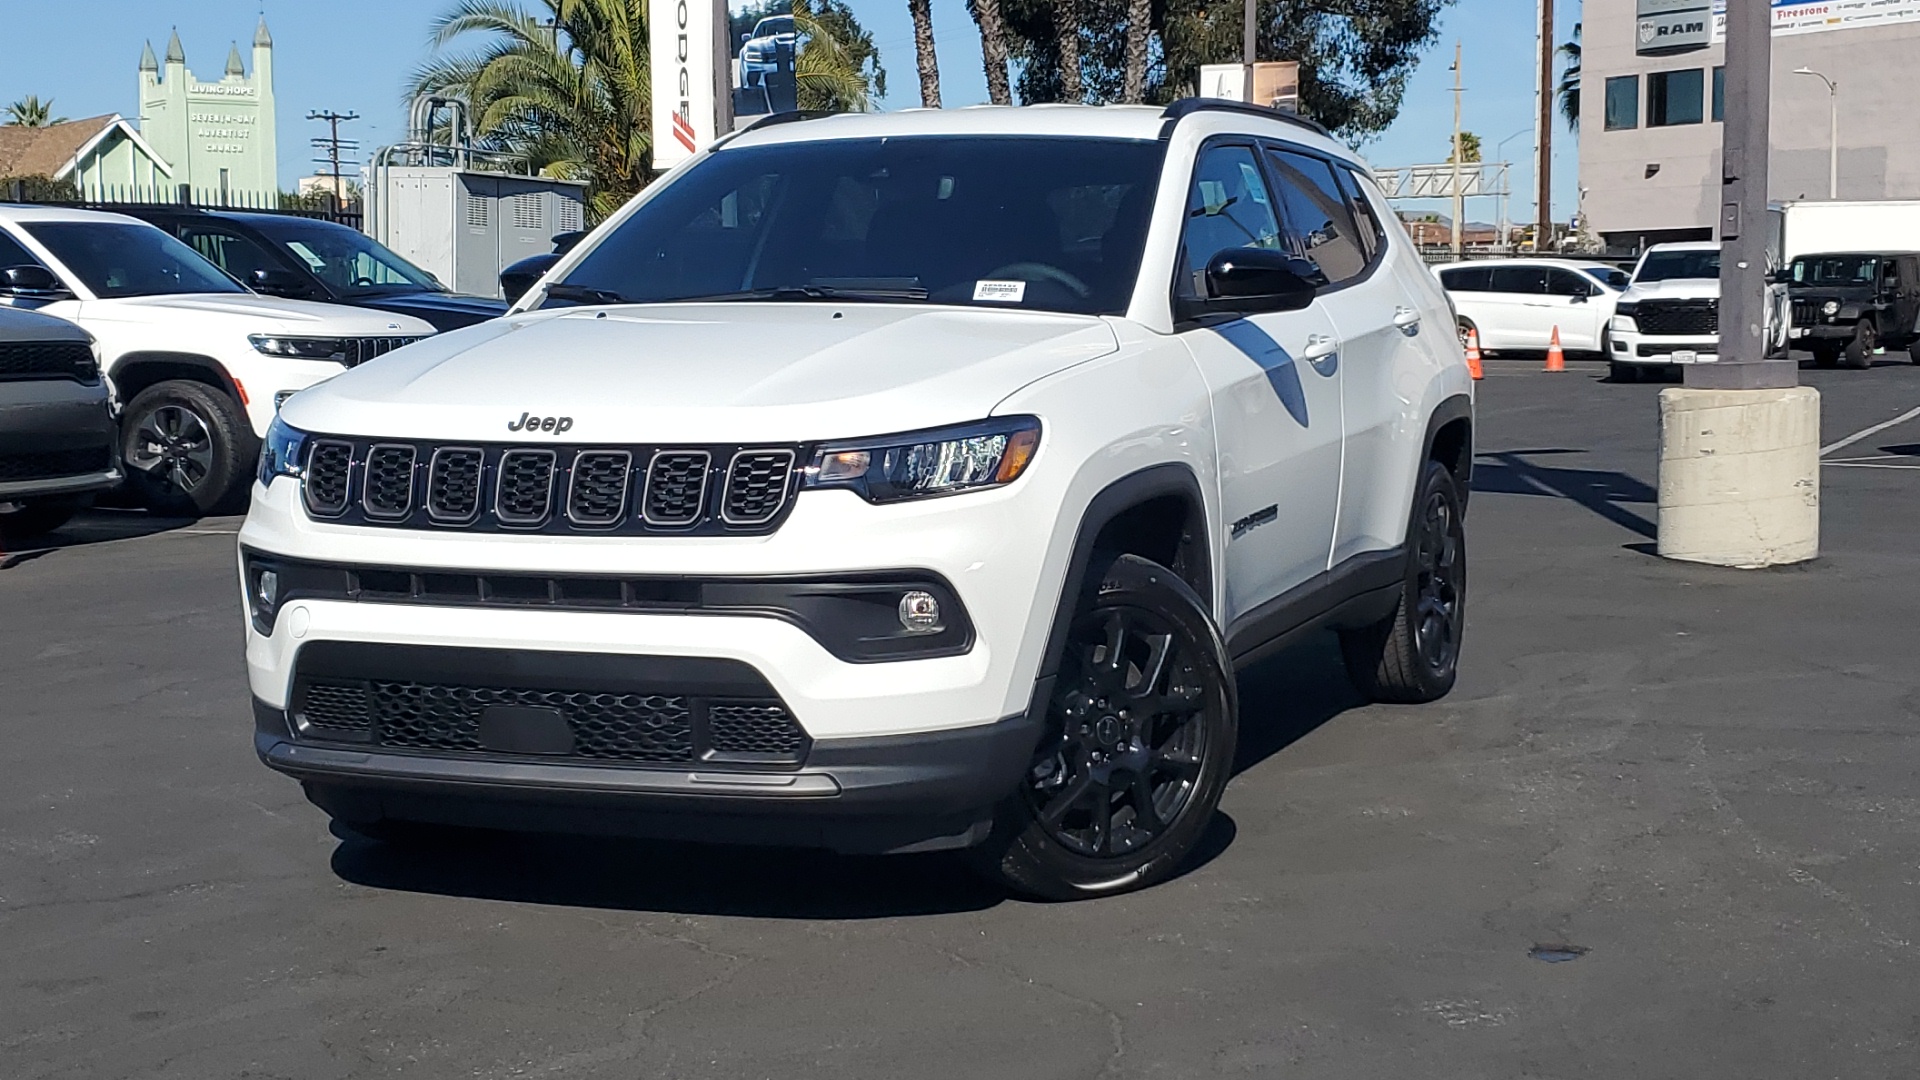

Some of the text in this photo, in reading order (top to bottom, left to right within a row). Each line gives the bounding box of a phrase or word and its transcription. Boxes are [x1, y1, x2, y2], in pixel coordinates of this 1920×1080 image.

[1776, 6, 1829, 20] Firestone
[1656, 22, 1704, 36] RAM
[189, 84, 254, 96] LIVING HOPE
[198, 128, 249, 139] ADVENTIST
[206, 144, 244, 153] CHURCH
[507, 412, 574, 436] Jeep
